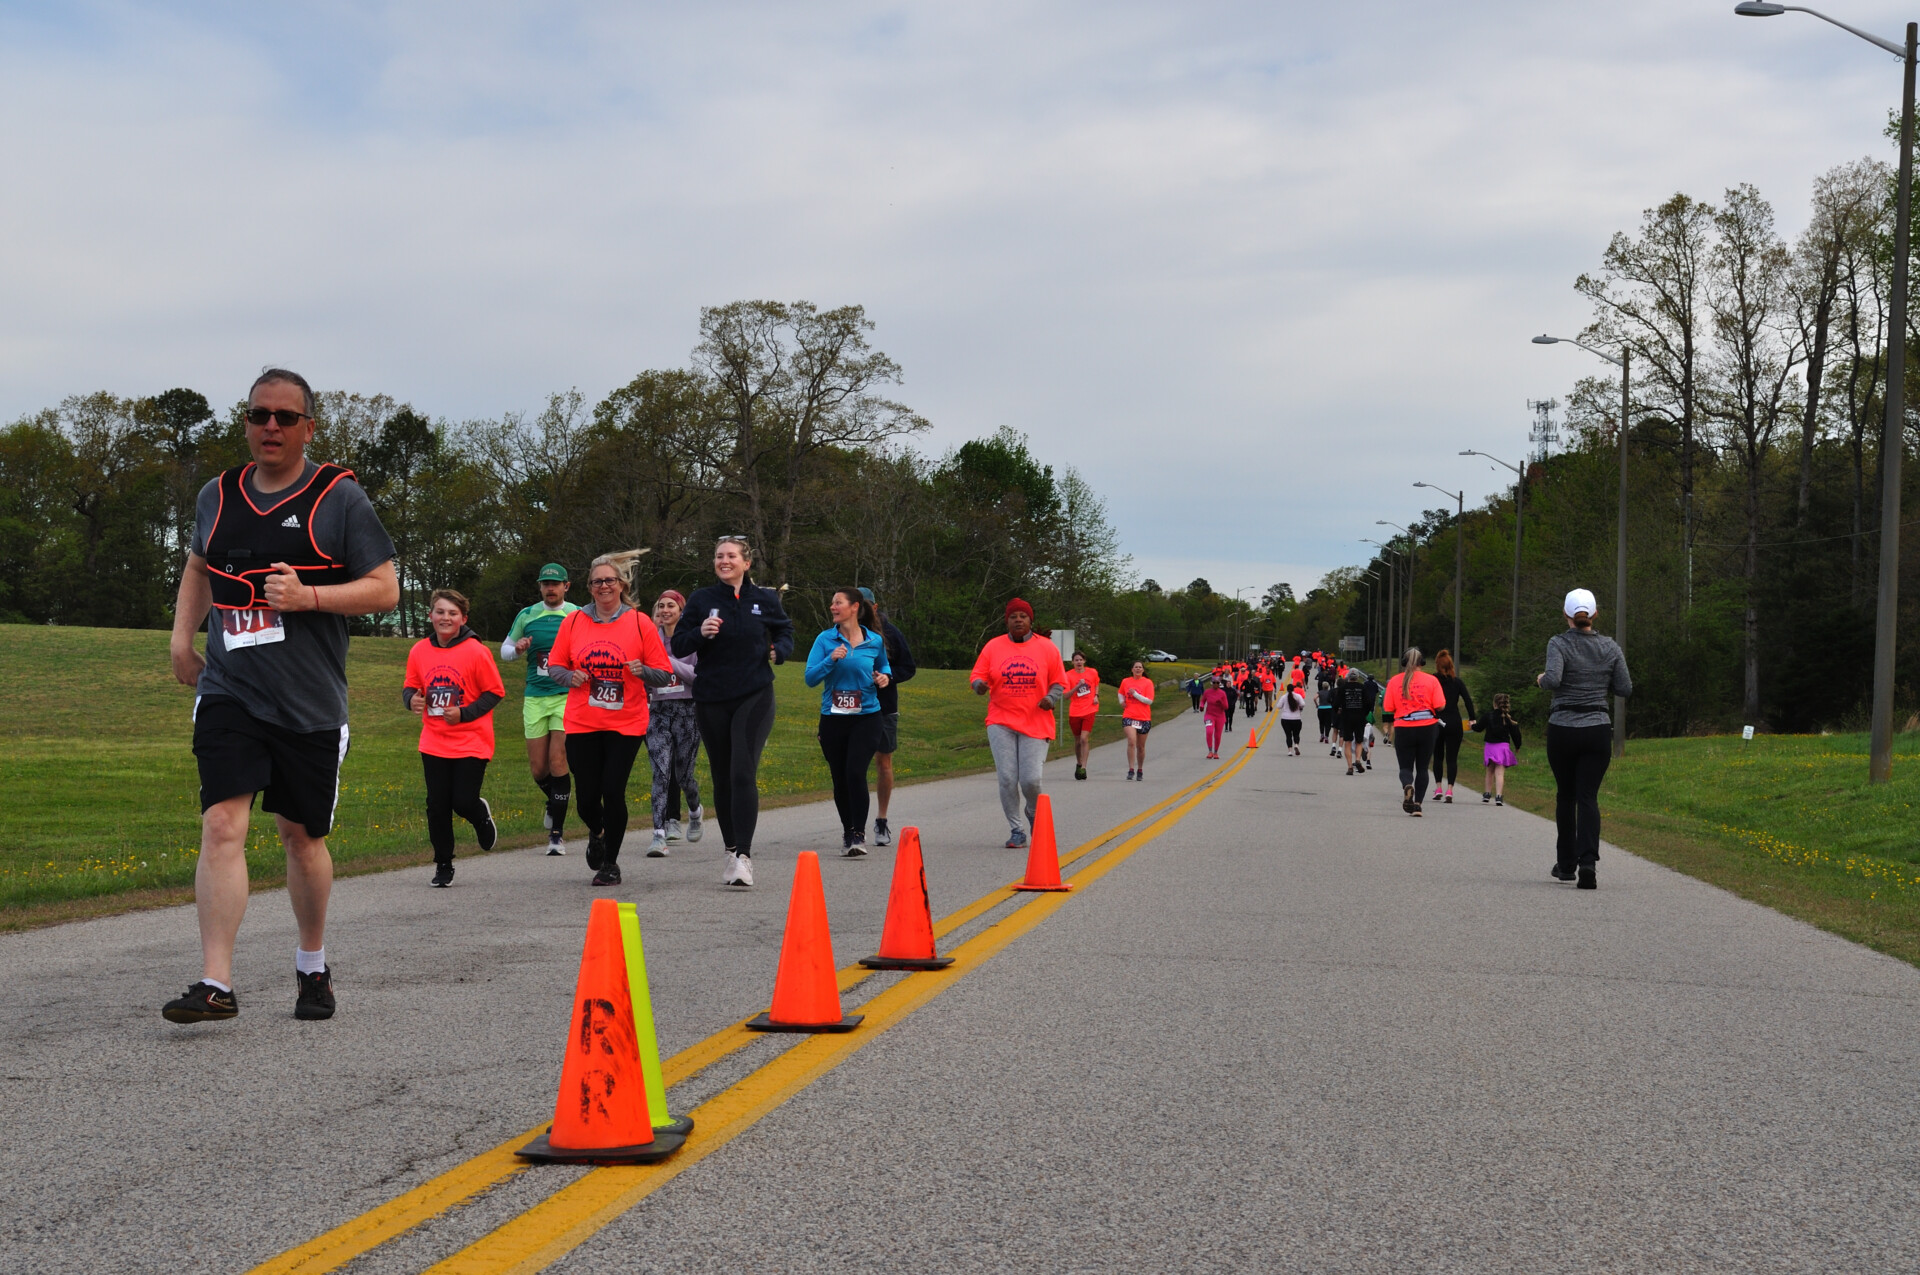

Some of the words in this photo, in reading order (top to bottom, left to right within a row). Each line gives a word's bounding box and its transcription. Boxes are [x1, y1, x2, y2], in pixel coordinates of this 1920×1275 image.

[232, 609, 265, 632] 191
[431, 692, 452, 708] 247
[597, 686, 617, 702] 245
[837, 696, 855, 708] 258
